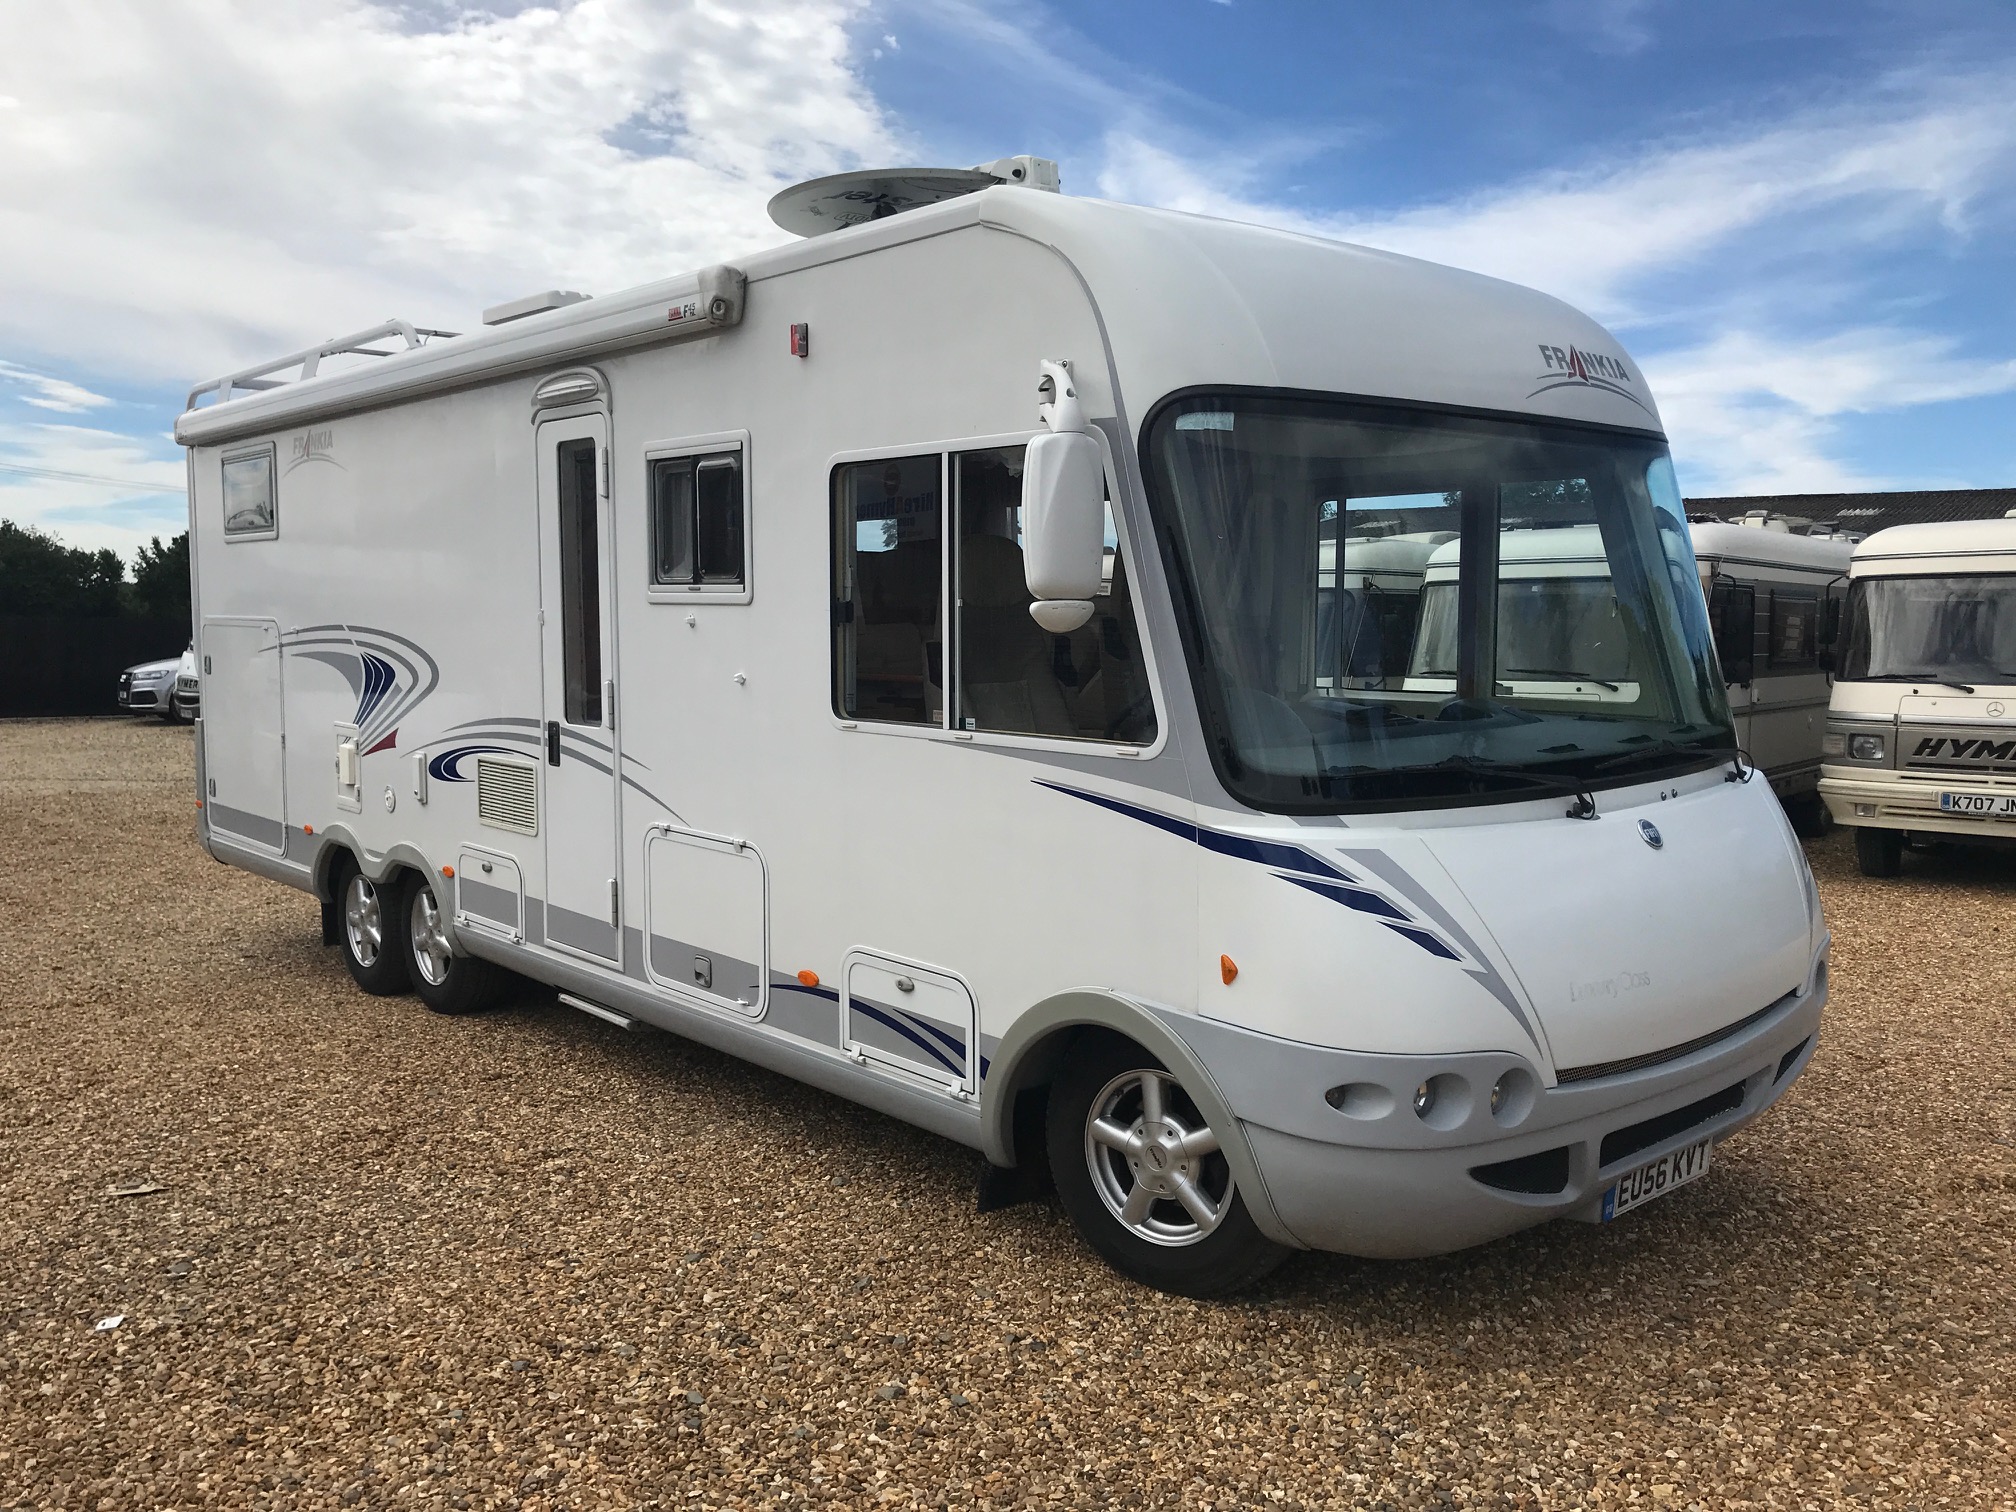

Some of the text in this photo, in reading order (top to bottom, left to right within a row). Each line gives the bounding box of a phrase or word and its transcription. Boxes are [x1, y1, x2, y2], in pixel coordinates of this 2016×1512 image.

[1538, 344, 1631, 384] FRANKIA
[293, 430, 333, 457] FRANKIA
[1912, 738, 2016, 760] HYM
[1952, 796, 1995, 811] K707
[1617, 1139, 1710, 1209] EU56 KVT
